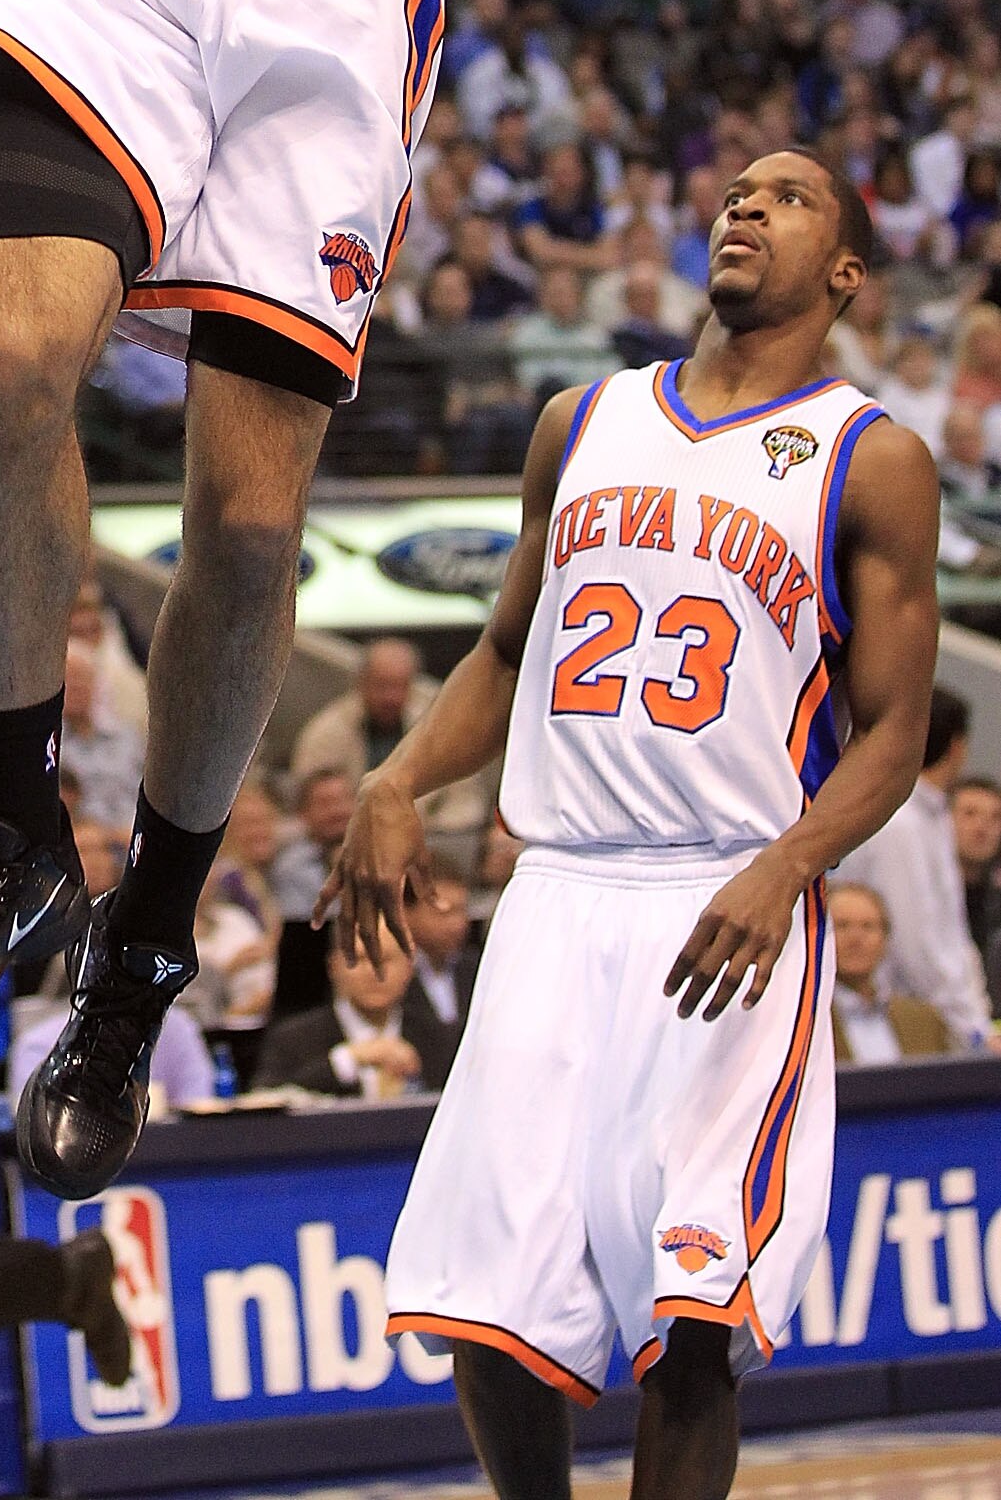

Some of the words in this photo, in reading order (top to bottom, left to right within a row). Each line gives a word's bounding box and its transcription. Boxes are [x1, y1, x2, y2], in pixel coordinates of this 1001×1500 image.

[319, 233, 375, 291] KNICKS
[552, 485, 677, 570] UEVA
[693, 493, 816, 653] YORK
[550, 582, 742, 735] 23
